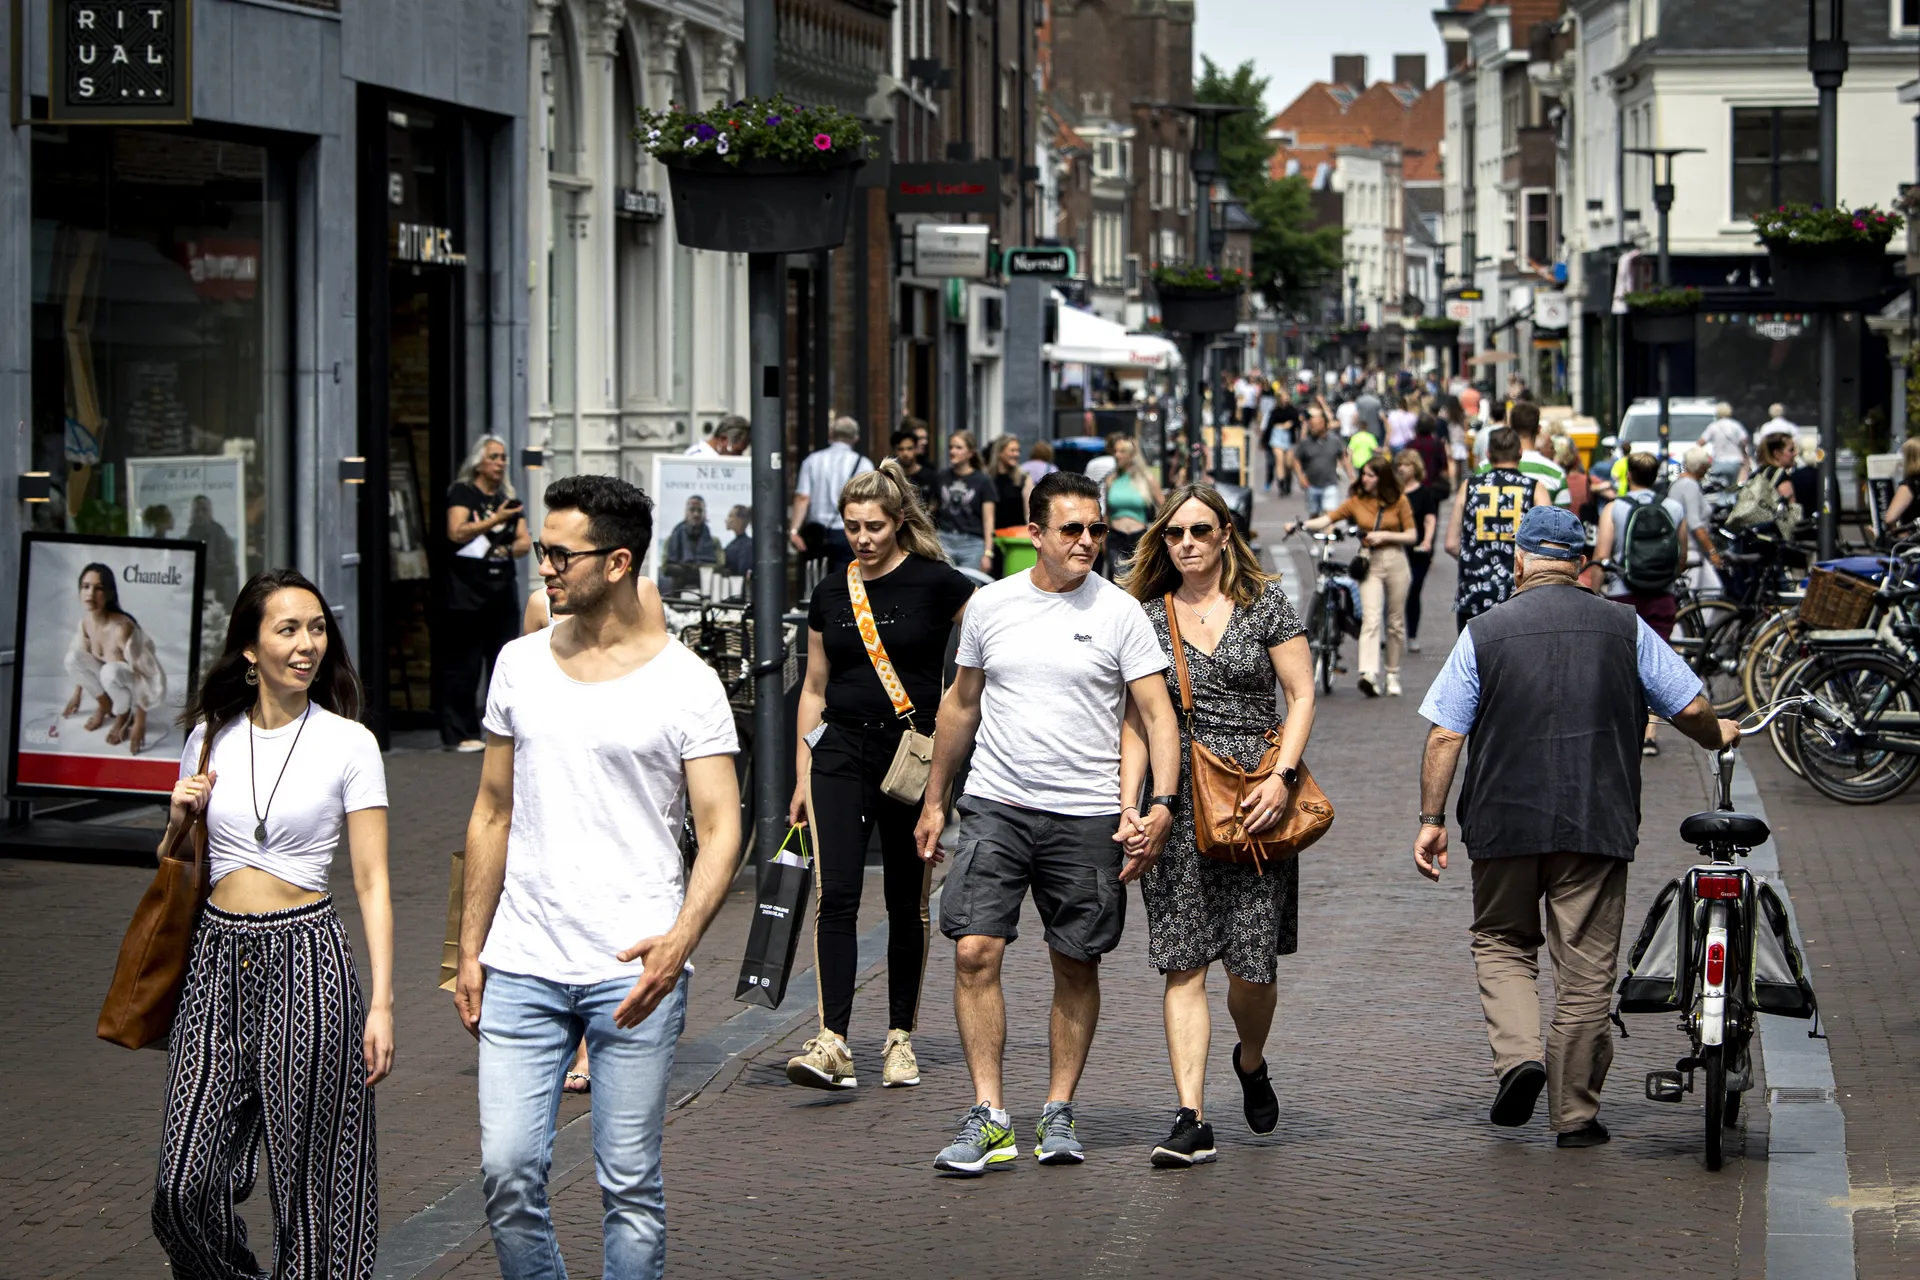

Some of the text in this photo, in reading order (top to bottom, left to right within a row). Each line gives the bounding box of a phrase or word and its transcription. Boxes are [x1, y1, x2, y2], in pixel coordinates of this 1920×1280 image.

[1013, 254, 1065, 271] Normal
[696, 467, 736, 479] NEW
[1476, 485, 1523, 541] 23
[1475, 541, 1513, 560] PARIS
[123, 563, 182, 586] Chantelle
